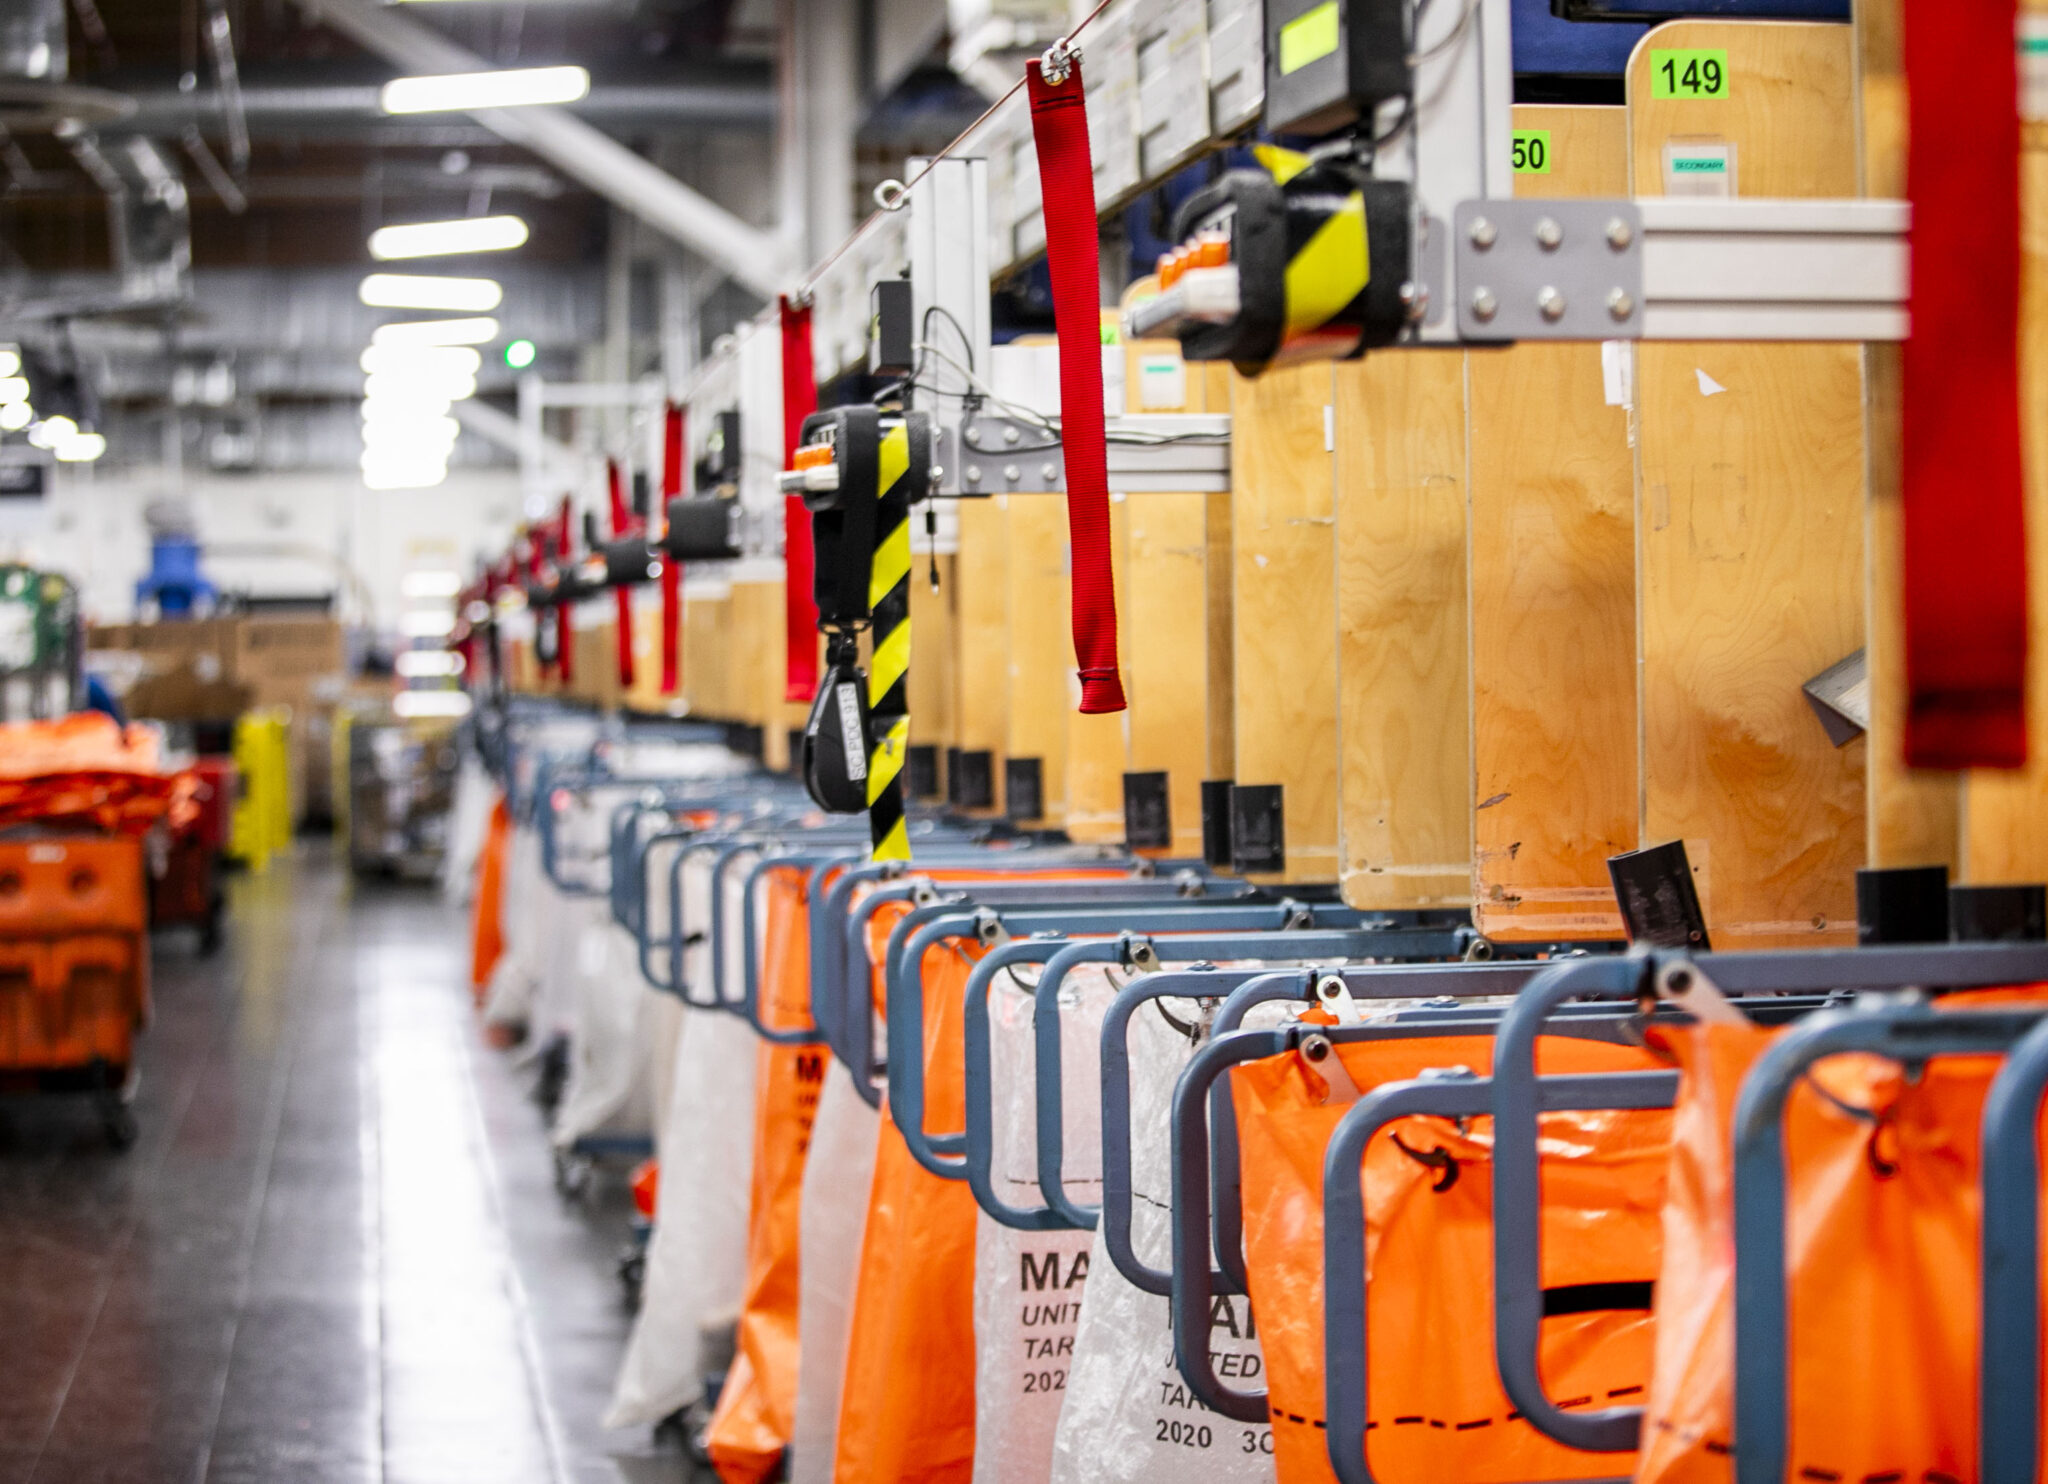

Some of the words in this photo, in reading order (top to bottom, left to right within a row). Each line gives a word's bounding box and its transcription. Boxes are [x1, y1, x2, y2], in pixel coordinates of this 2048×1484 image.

[1662, 58, 1722, 94] 149
[1021, 1251, 1090, 1291] MA
[1022, 1303, 1082, 1326] UNIT
[1023, 1369, 1069, 1394] 202
[1156, 1418, 1213, 1449] 2020
